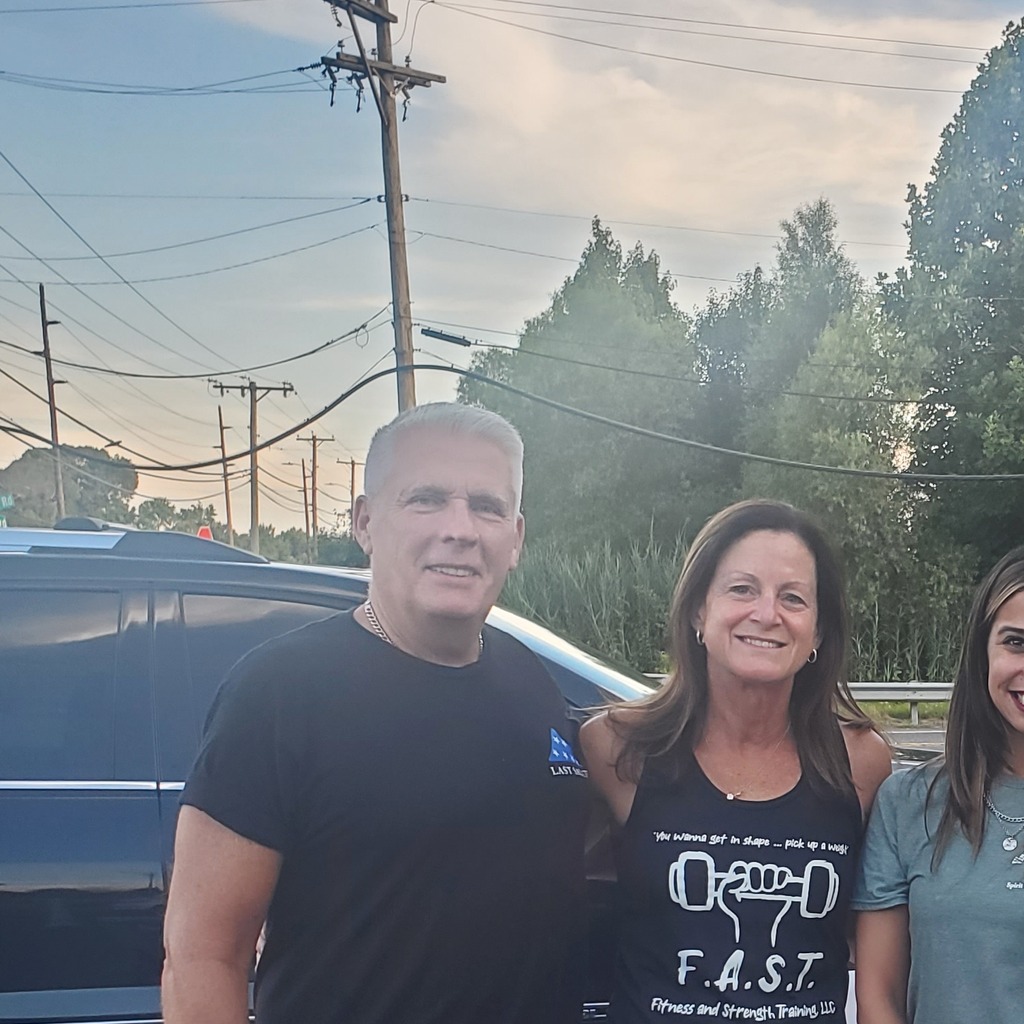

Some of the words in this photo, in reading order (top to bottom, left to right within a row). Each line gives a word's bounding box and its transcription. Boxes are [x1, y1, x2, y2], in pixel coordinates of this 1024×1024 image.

[549, 766, 572, 776] LAST
[673, 832, 707, 842] wanna
[709, 834, 728, 845] get
[730, 835, 740, 845] in
[742, 836, 770, 848] shape
[785, 838, 805, 850] pick
[807, 840, 819, 852] up
[820, 842, 826, 851] a
[1006, 881, 1023, 890] Spirit
[677, 948, 824, 993] F.A.S.T.
[650, 997, 695, 1015] Fitness
[696, 1002, 721, 1016] and
[722, 1003, 776, 1021] Strength
[820, 1000, 836, 1015] LLC
